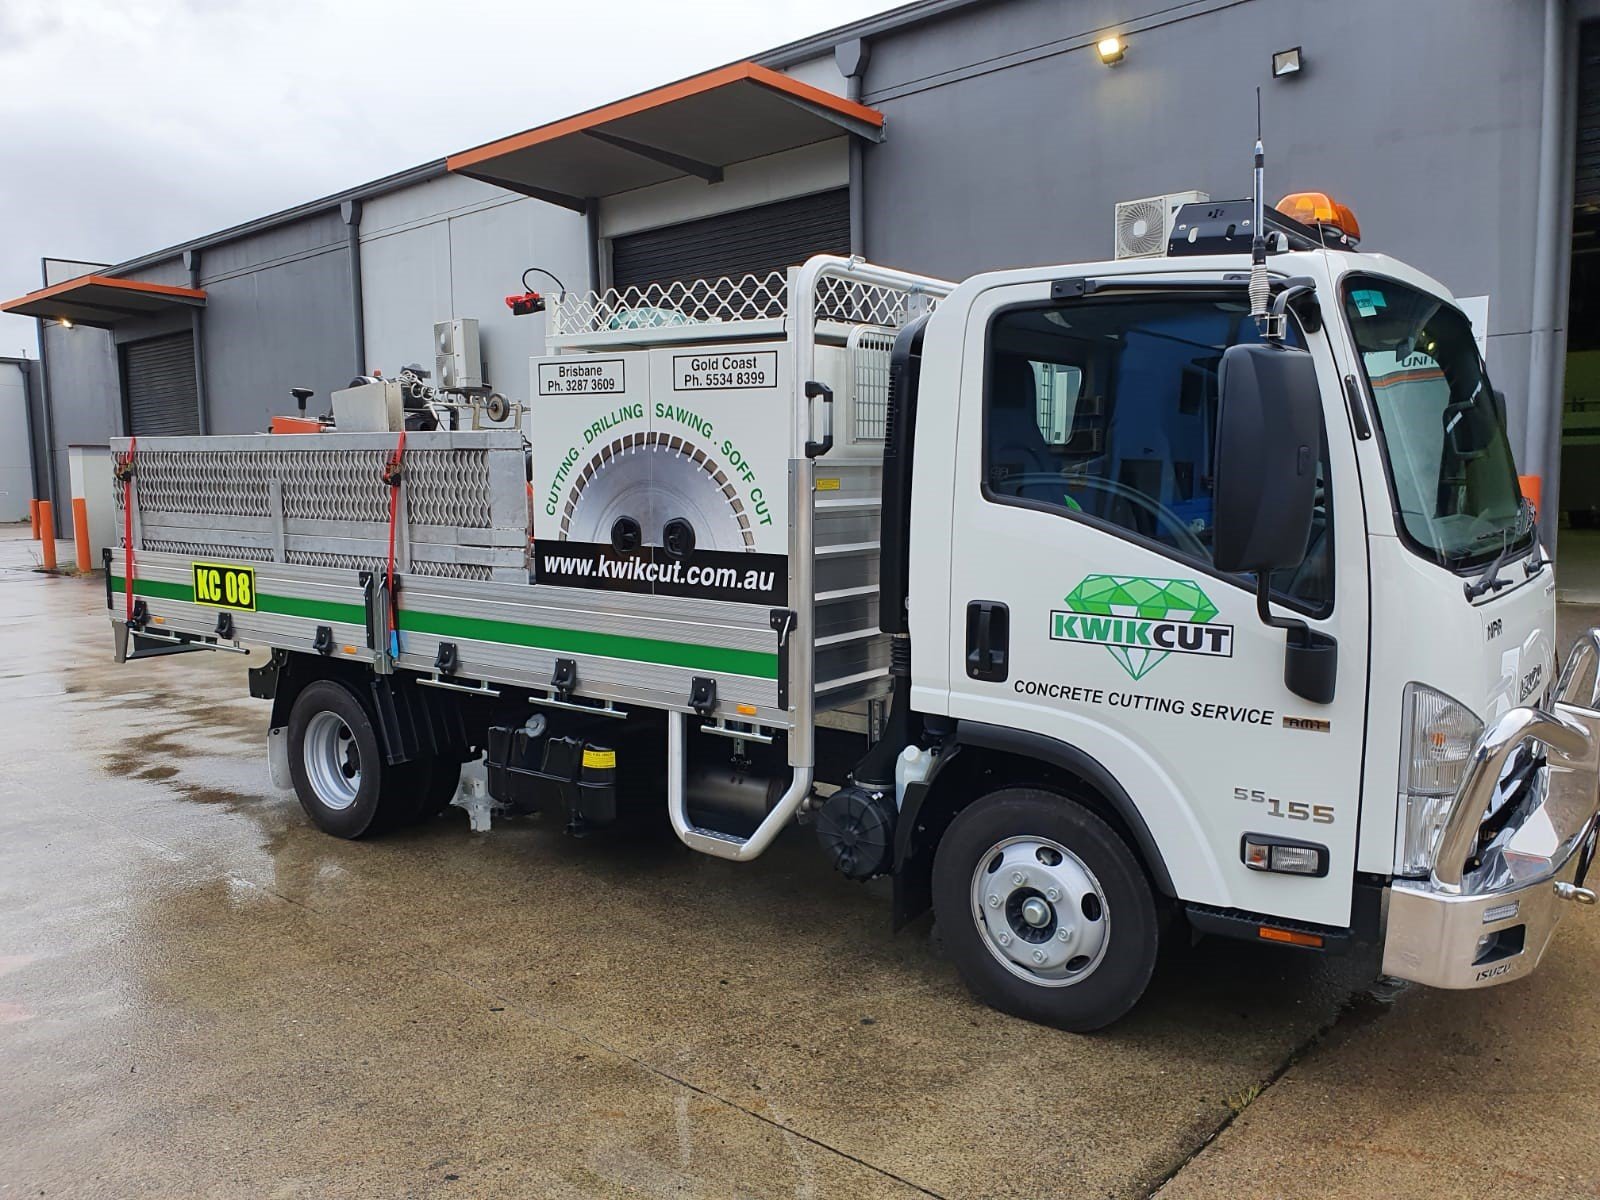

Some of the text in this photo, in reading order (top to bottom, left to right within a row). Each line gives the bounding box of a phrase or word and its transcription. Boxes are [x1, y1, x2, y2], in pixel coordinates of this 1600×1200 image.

[559, 365, 602, 378] Brisbane
[684, 371, 765, 387] Ph. 5534 8399
[691, 356, 757, 372] Gold Coast
[547, 379, 615, 392] Ph. 3287 3609
[545, 402, 772, 527] CUTTING DRILLING SAWING SOFF CUT
[197, 568, 251, 605] KC 08
[544, 554, 775, 591] www.kwikcut.com.au
[1054, 614, 1230, 653] KWIKCUT
[1014, 680, 1275, 727] CONCRETE CUTTING SERVICE
[1233, 787, 1335, 825] 55 155
[1476, 962, 1511, 981] ISUZU
